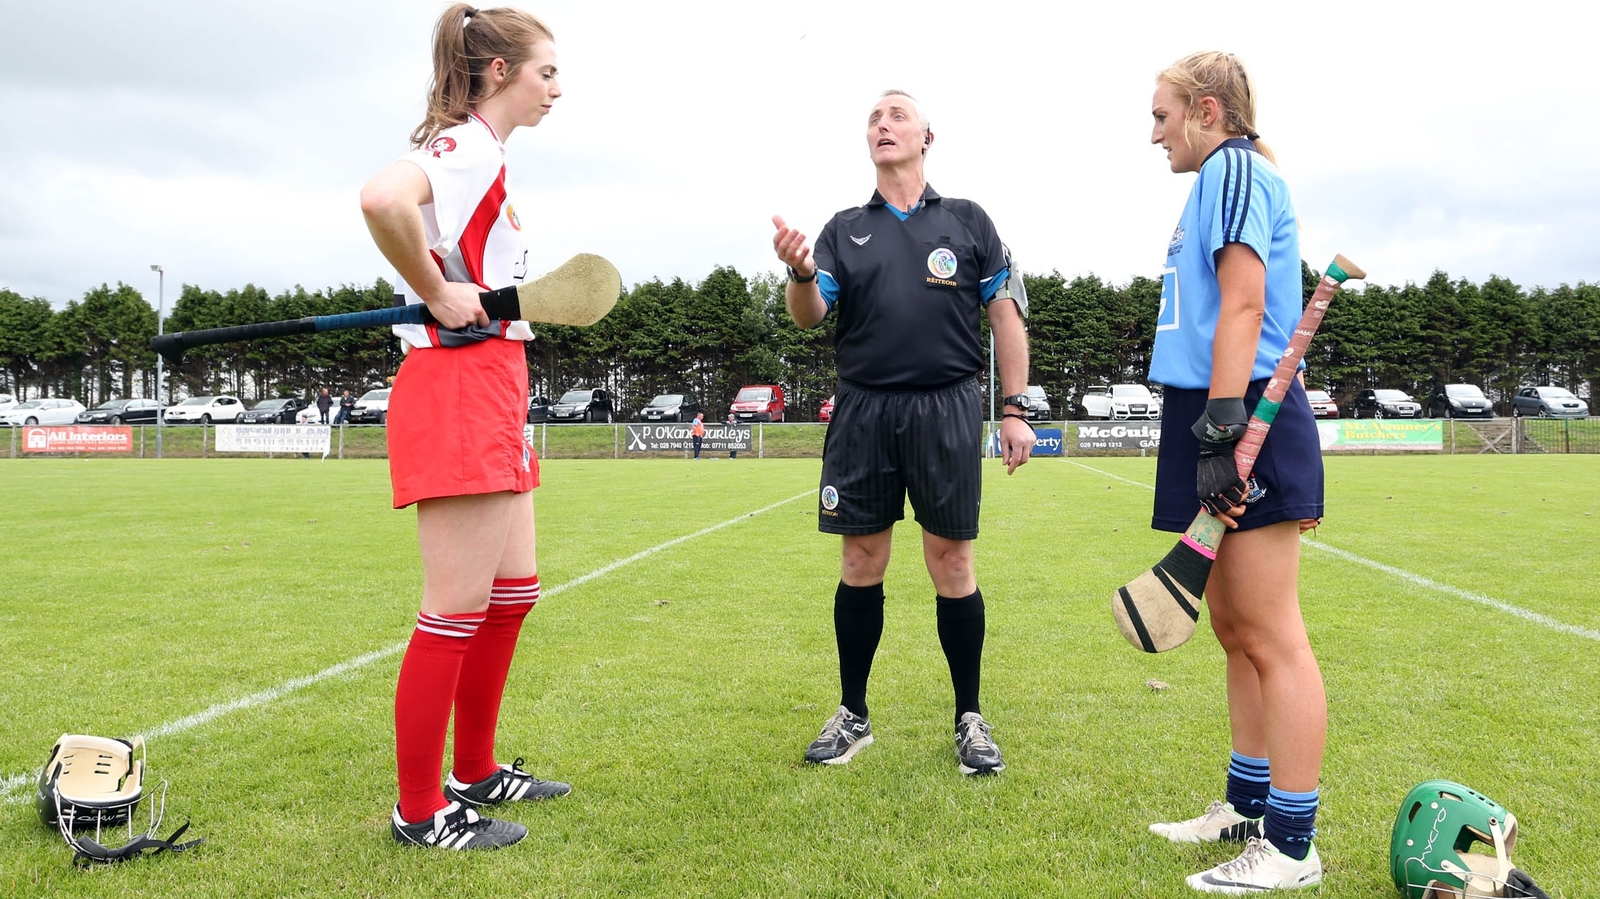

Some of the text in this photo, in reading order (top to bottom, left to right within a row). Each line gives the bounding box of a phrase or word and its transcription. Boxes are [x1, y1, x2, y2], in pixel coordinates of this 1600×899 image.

[926, 277, 957, 287] RÉITEOIR
[49, 431, 128, 441] All Interiors
[642, 426, 654, 440] P.
[1078, 426, 1161, 440] McGuig
[1345, 430, 1406, 439] Butchers
[1034, 437, 1062, 452] erty
[1420, 806, 1447, 868] mycro
